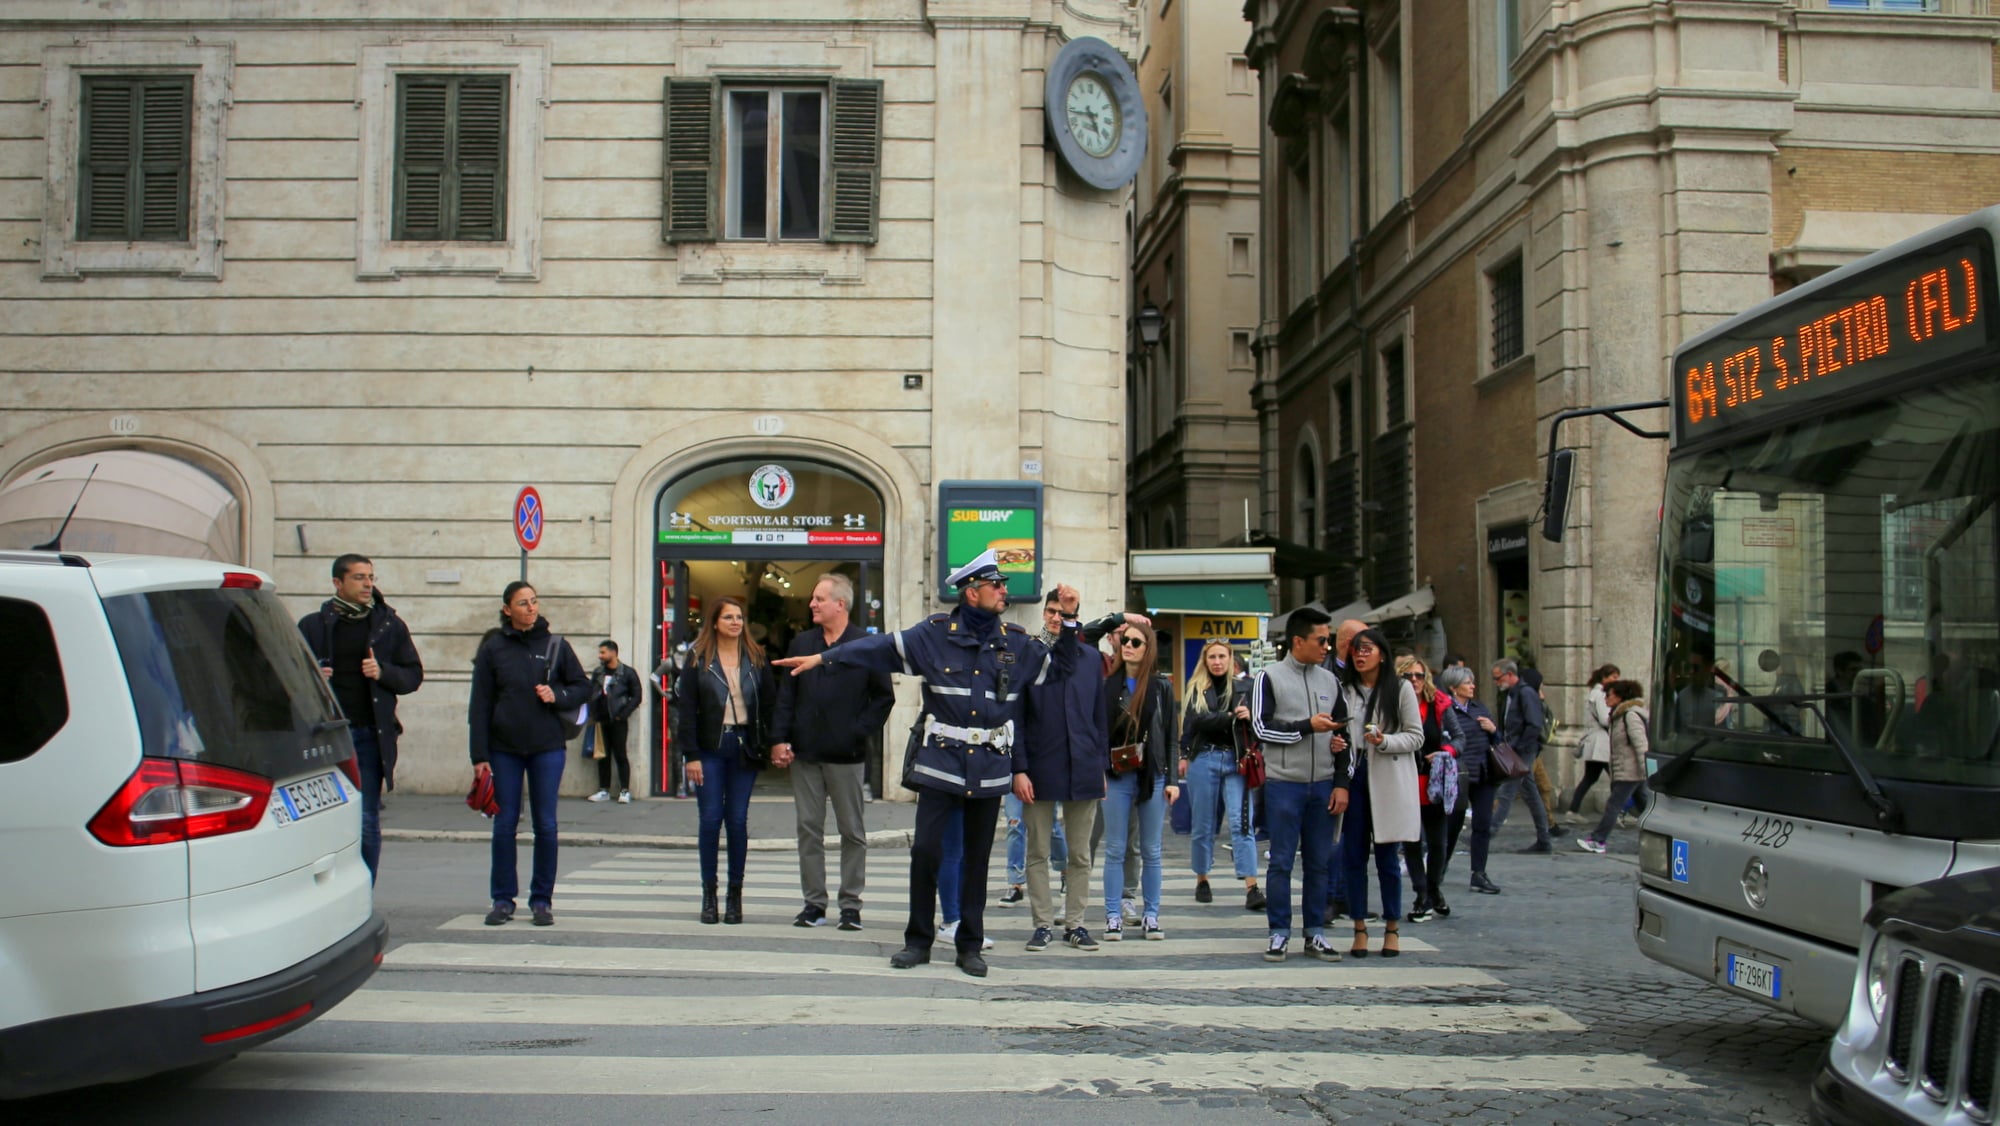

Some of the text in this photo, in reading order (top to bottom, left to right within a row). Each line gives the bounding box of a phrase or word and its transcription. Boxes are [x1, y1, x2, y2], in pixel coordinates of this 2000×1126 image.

[1687, 361, 1718, 424] 64
[1770, 295, 1890, 392] S.PIETRO
[1905, 256, 1979, 343] (FL)
[114, 418, 135, 431] 116
[757, 418, 779, 431] 117
[707, 515, 832, 526] SPORTSWEAR STORE
[951, 510, 1013, 522] SUBWAY
[1199, 620, 1244, 635] ATM
[1741, 815, 1794, 849] 4428
